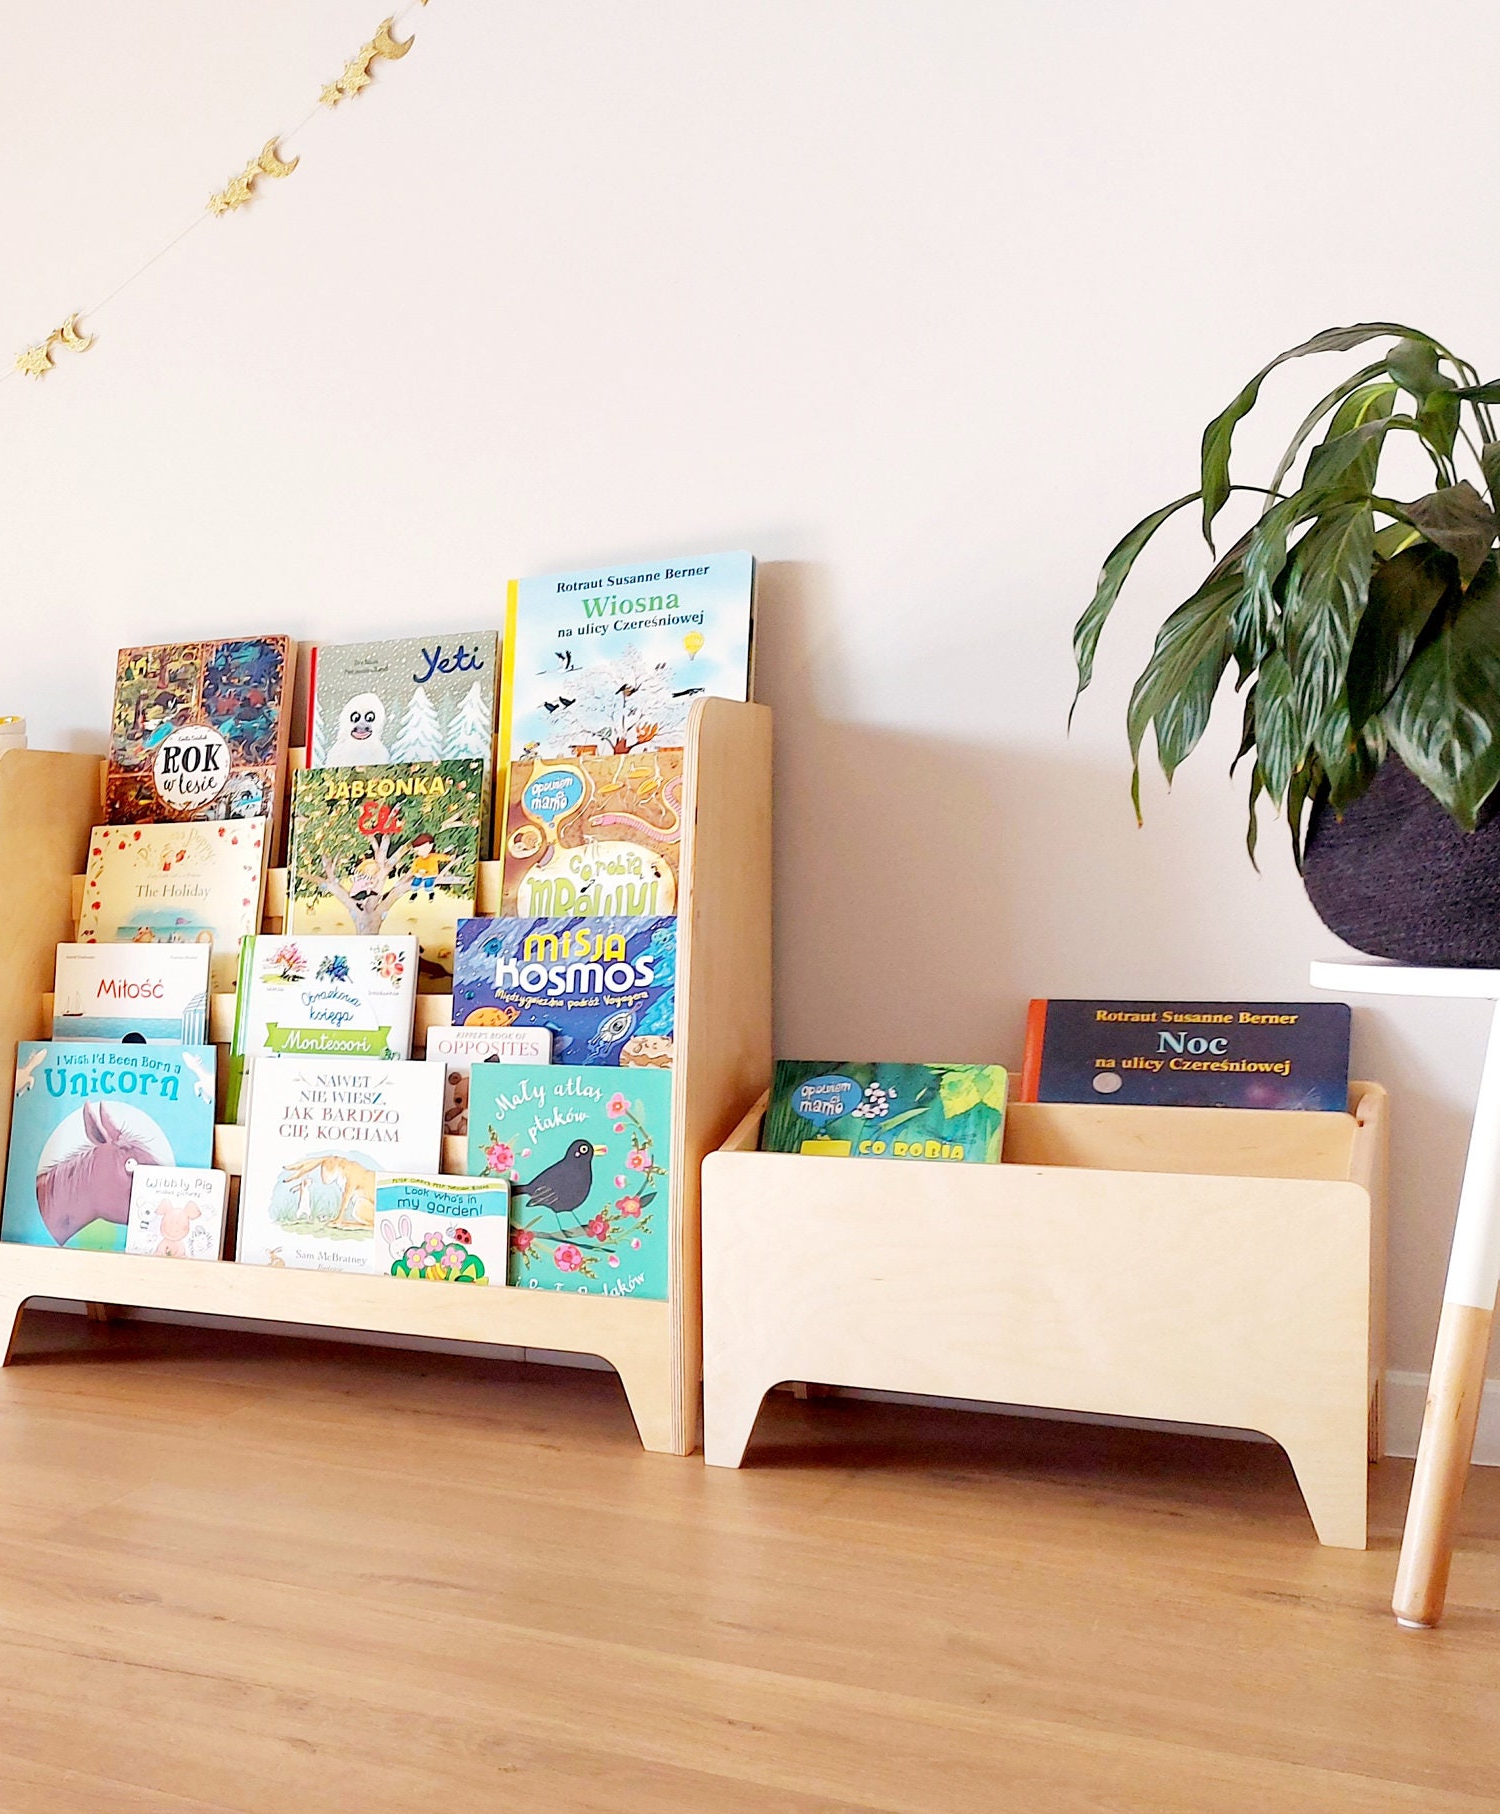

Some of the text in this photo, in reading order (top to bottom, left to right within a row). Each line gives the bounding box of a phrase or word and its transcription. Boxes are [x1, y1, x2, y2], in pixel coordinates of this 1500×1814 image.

[556, 565, 710, 593] Rotraut Susanne Berner
[582, 593, 680, 619] Wiosna
[557, 610, 705, 638] na ulicy Czereśniowej
[413, 645, 484, 683] Yeti
[161, 744, 222, 774] ROK
[164, 773, 217, 794] w lesie
[325, 776, 446, 800] JABŁONKA
[136, 883, 211, 901] The Holiday
[97, 979, 164, 999] Miłość
[1096, 1009, 1299, 1025] Rotraut Susanne Berner
[281, 1030, 372, 1052] Montessori
[438, 1040, 540, 1057] OPPOSITES
[1156, 1031, 1229, 1055] Noc
[64, 1055, 89, 1065] Wish
[92, 1053, 105, 1064] I'd
[108, 1054, 138, 1067] Been
[141, 1056, 171, 1072] Born
[174, 1065, 181, 1074] a
[1095, 1057, 1291, 1076] na ulicy Czereśniowej
[44, 1068, 179, 1101] Unicorn
[316, 1074, 371, 1088] NAWET
[300, 1090, 327, 1103] NIE
[495, 1076, 603, 1120] Mały atlas
[282, 1107, 400, 1124] JAK BARDZO
[528, 1107, 591, 1144] ptaków
[316, 1126, 400, 1142] KOCHAM
[859, 1139, 887, 1155] CO
[146, 1178, 213, 1193] Wibbly Pig
[404, 1186, 477, 1204] Look who's in
[397, 1198, 483, 1217] my garden!
[295, 1249, 367, 1267] Sam McBratney
